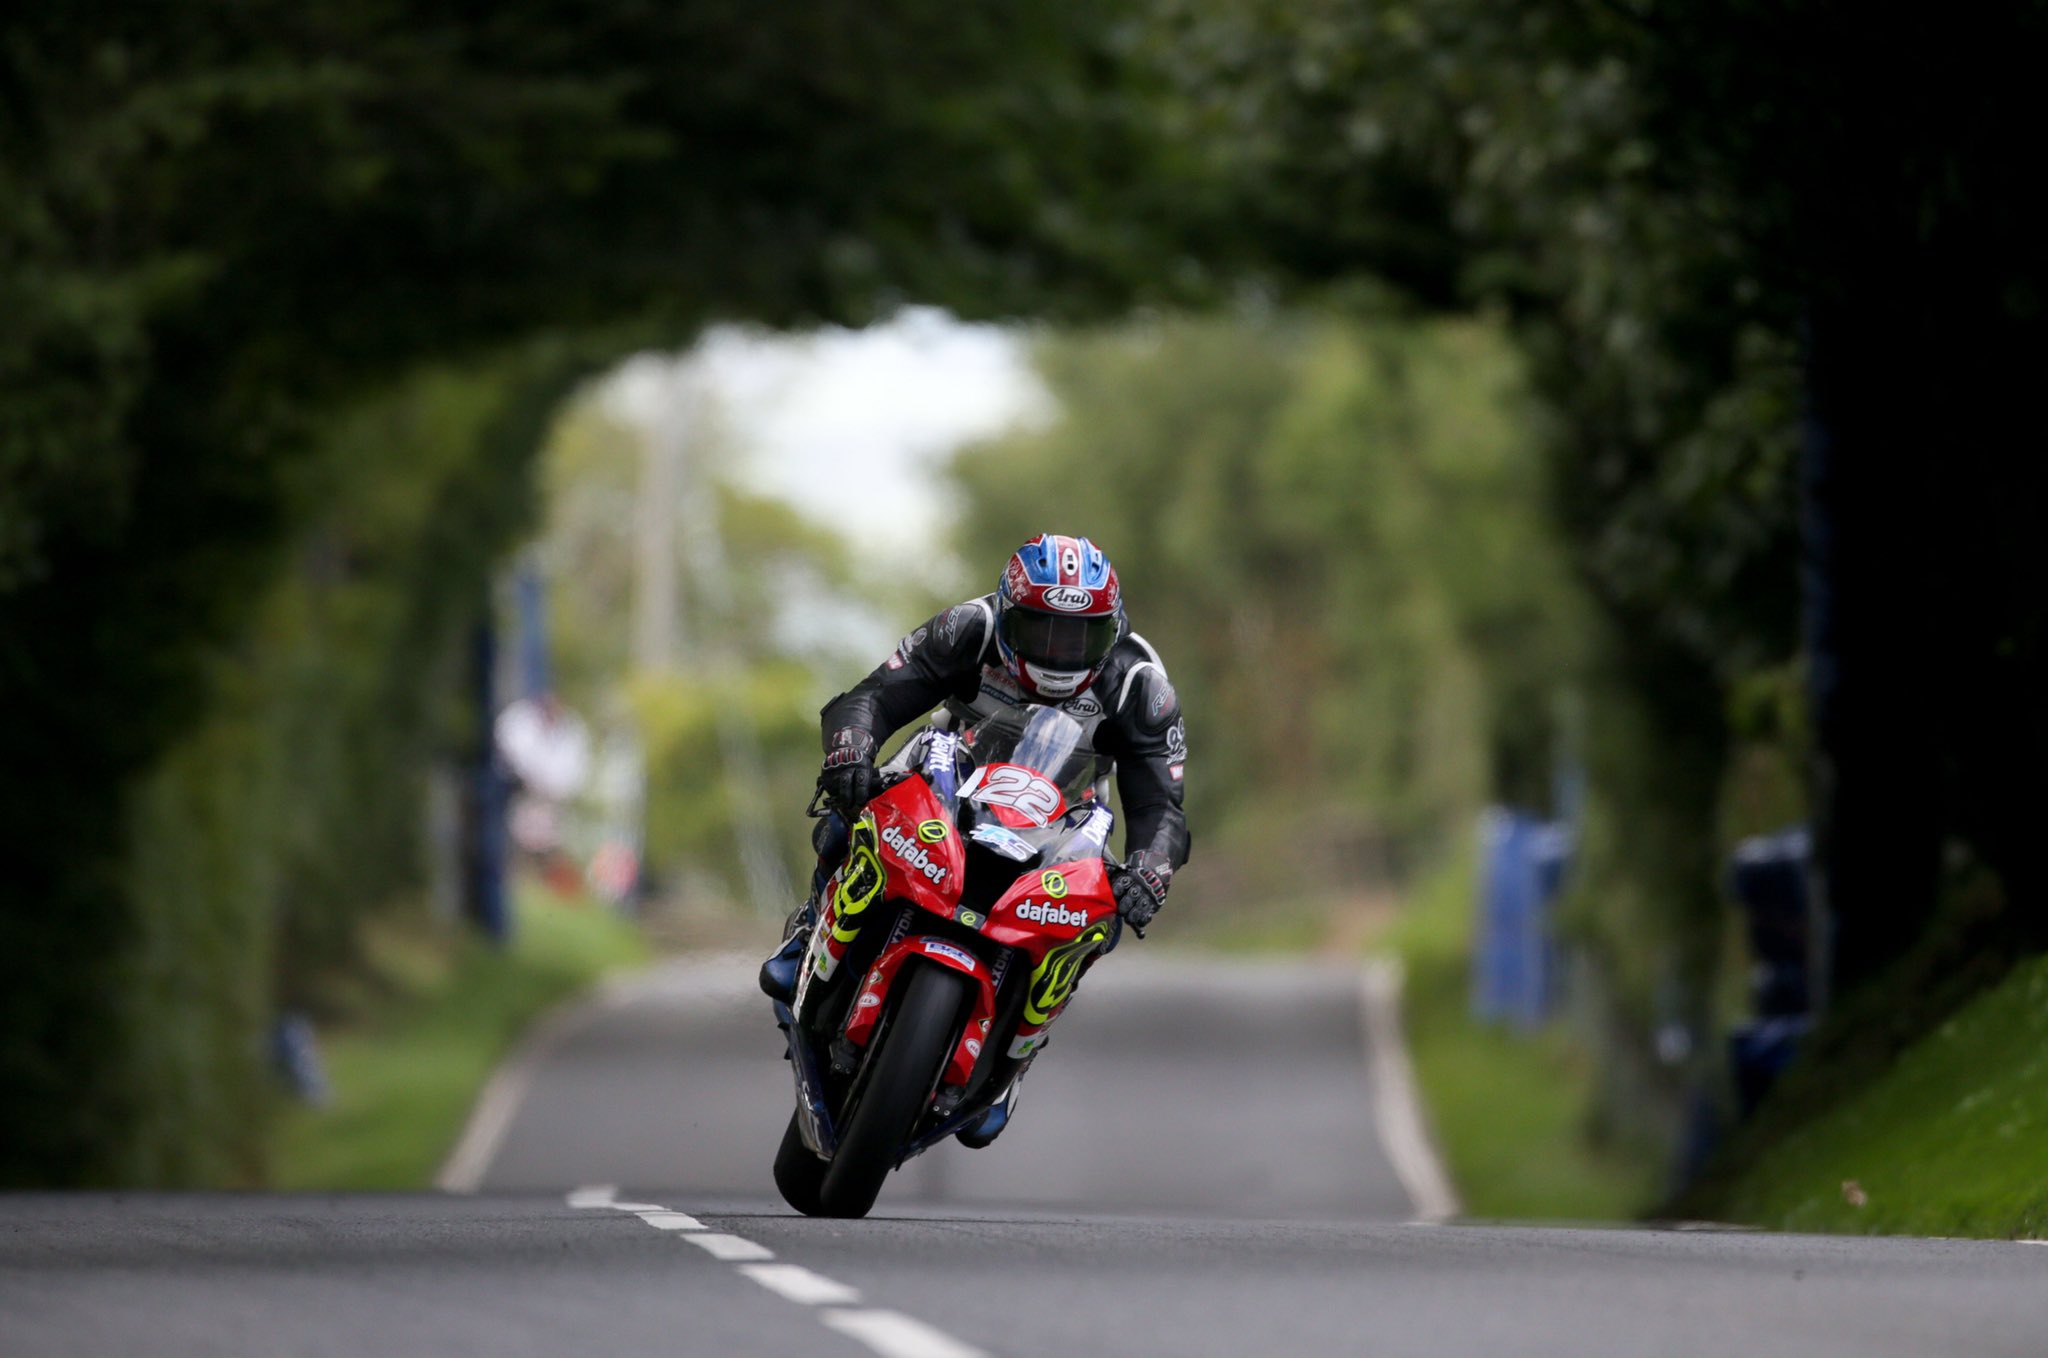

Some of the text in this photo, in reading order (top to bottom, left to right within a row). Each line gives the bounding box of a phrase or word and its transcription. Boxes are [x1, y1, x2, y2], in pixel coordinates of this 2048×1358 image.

[1047, 588, 1086, 605] Arai
[1065, 699, 1096, 713] Arai
[929, 731, 956, 773] Devitt
[973, 765, 1060, 828] 22
[881, 826, 947, 885] dafabet
[1016, 899, 1088, 928] dafabet
